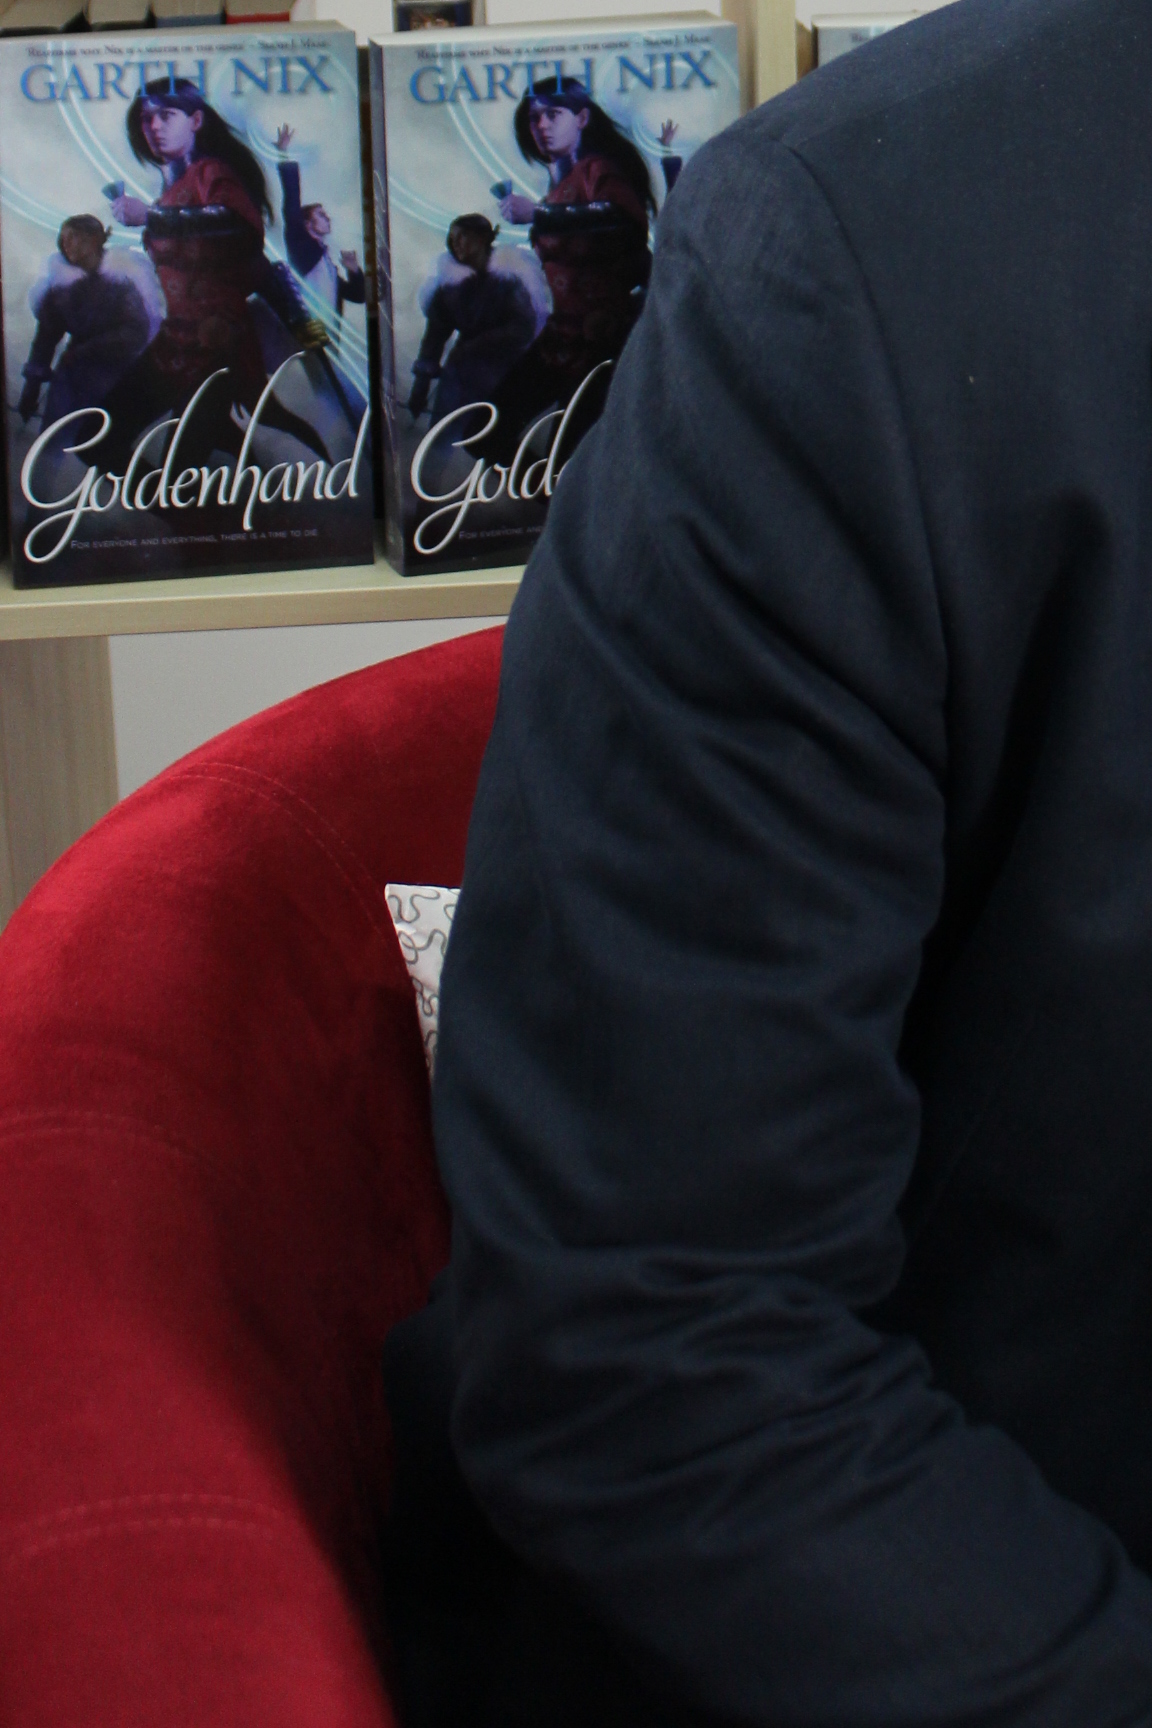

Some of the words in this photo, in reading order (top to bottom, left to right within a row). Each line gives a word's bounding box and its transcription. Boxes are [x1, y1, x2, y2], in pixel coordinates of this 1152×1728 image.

[20, 59, 208, 104] GARTH
[231, 55, 335, 96] NIX
[409, 57, 596, 105] GARTH
[615, 50, 718, 94] NIX
[22, 350, 371, 563] Goldenhand
[70, 539, 90, 549] FOR
[92, 538, 137, 549] EVERYONE
[140, 538, 159, 546] AND
[161, 535, 218, 545] EVERYTHING,
[220, 533, 248, 541] THERE
[267, 531, 287, 539] TIME
[303, 528, 318, 537] DIE
[459, 530, 478, 540] FOR
[480, 527, 523, 538] EVERYONE
